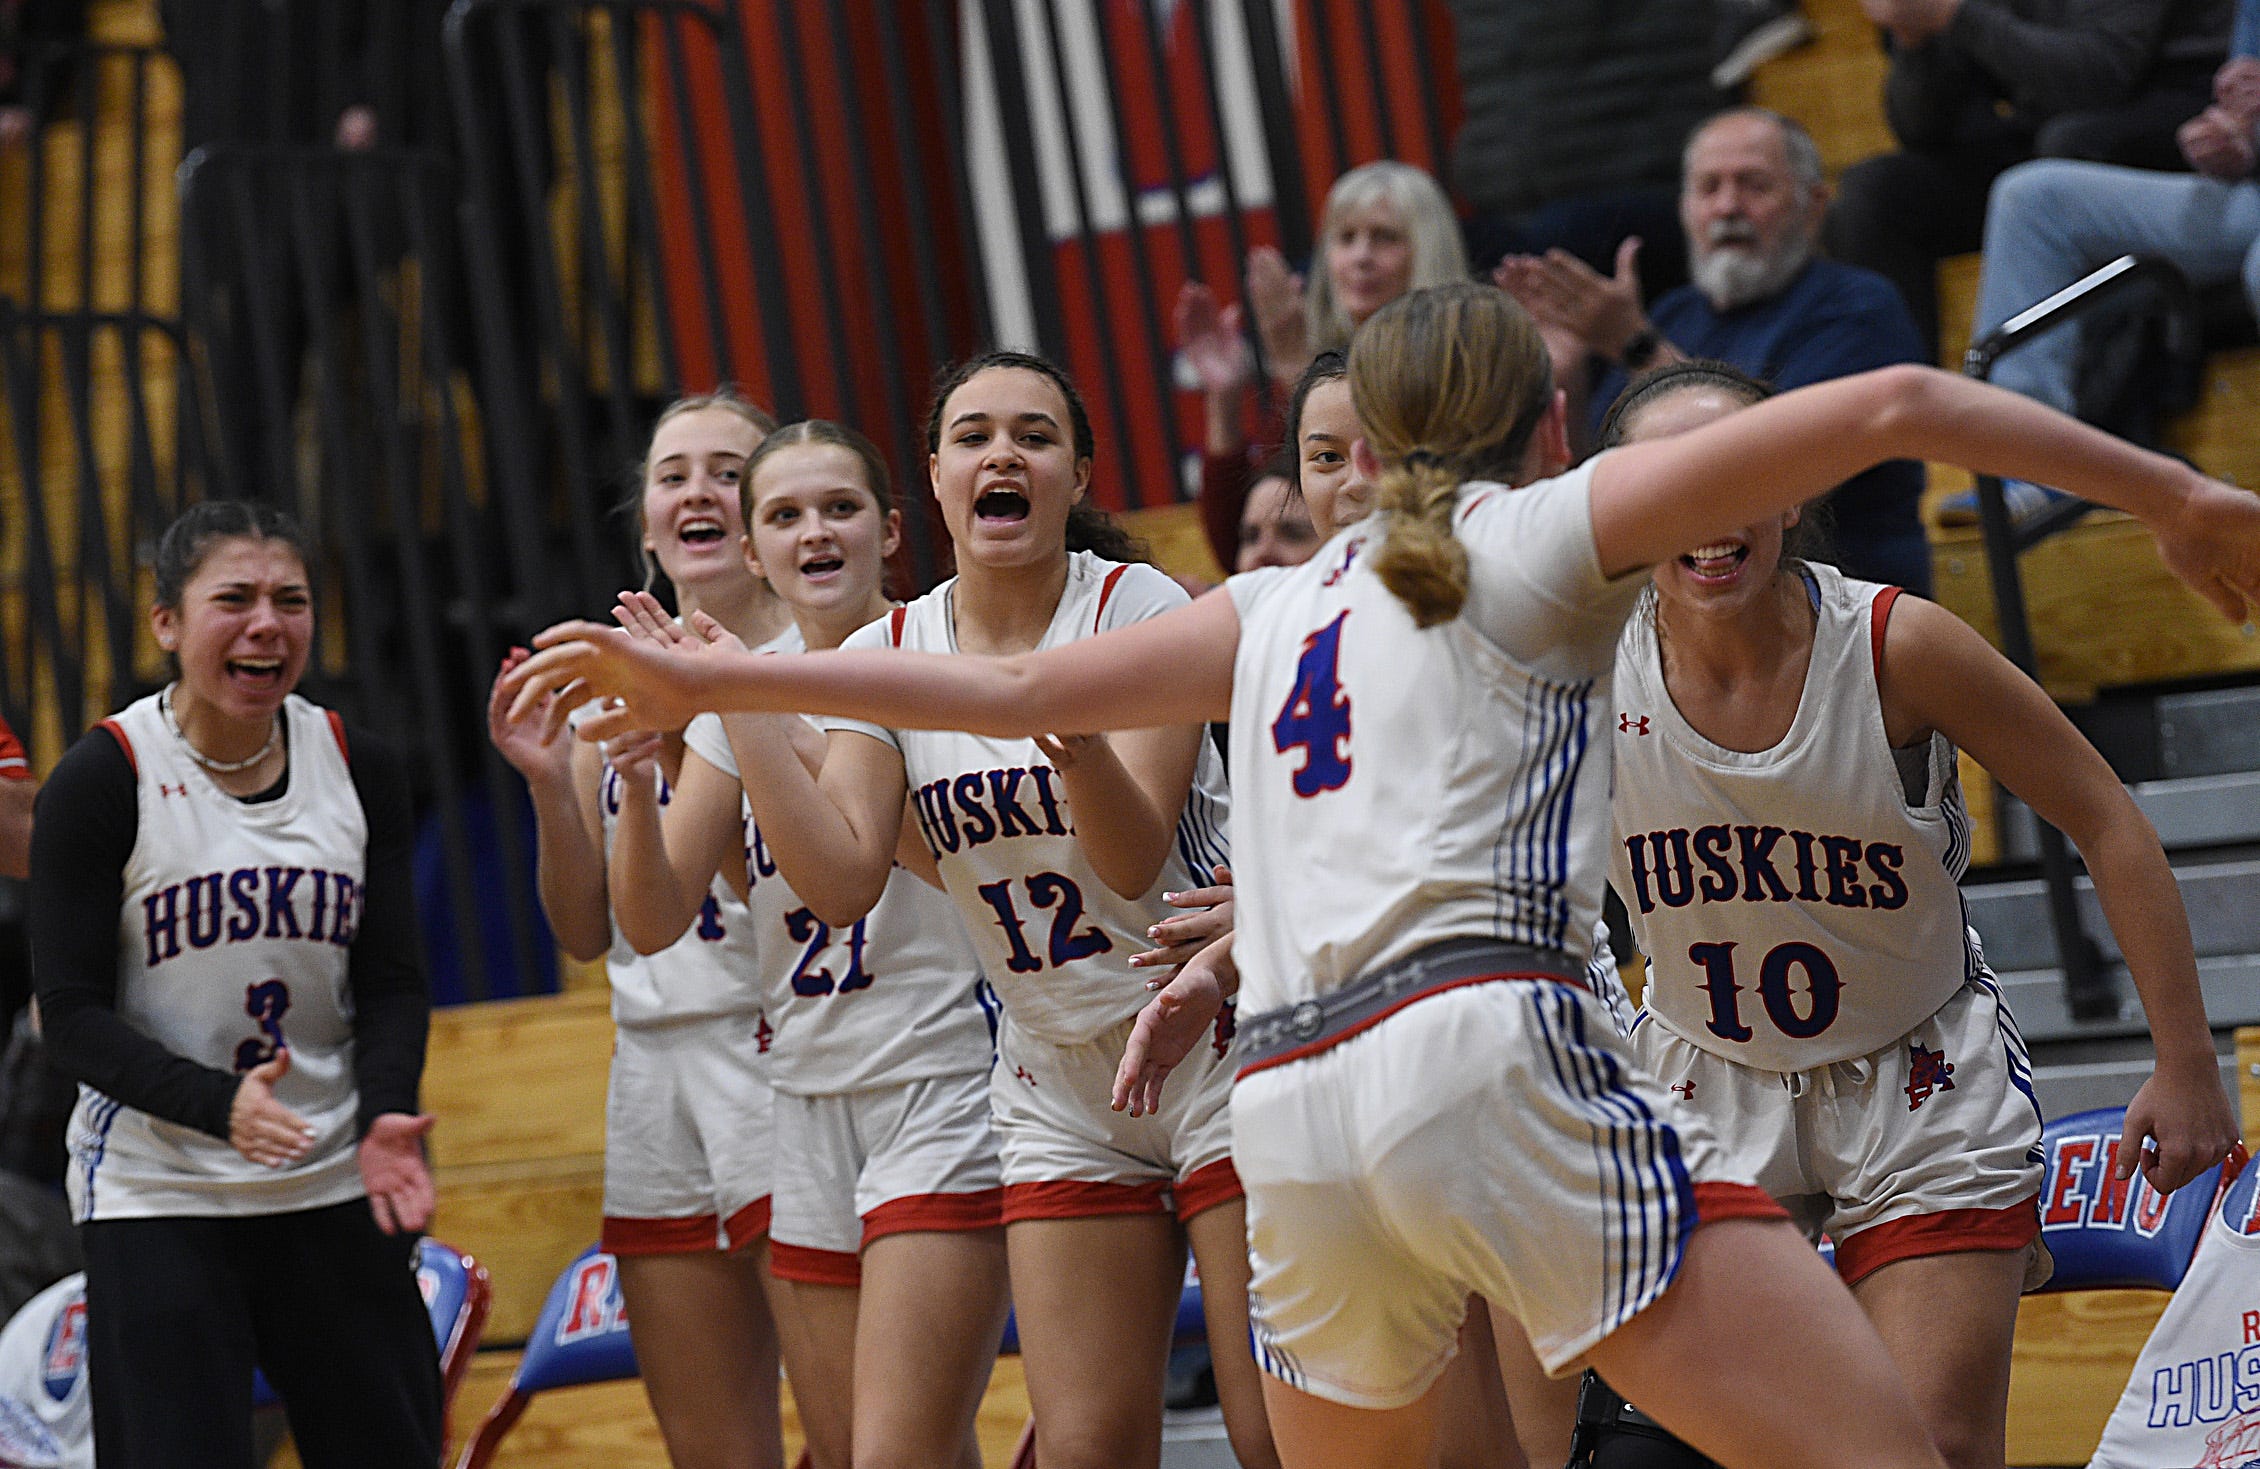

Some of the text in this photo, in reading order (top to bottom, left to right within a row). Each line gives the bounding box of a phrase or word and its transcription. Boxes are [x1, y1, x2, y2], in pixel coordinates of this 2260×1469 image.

[1271, 609, 1352, 799] 4
[142, 866, 365, 967] HUSKIE
[785, 907, 875, 998] 21
[978, 872, 1113, 973] 12
[234, 979, 293, 1072] 3
[1688, 941, 1847, 1043] 10
